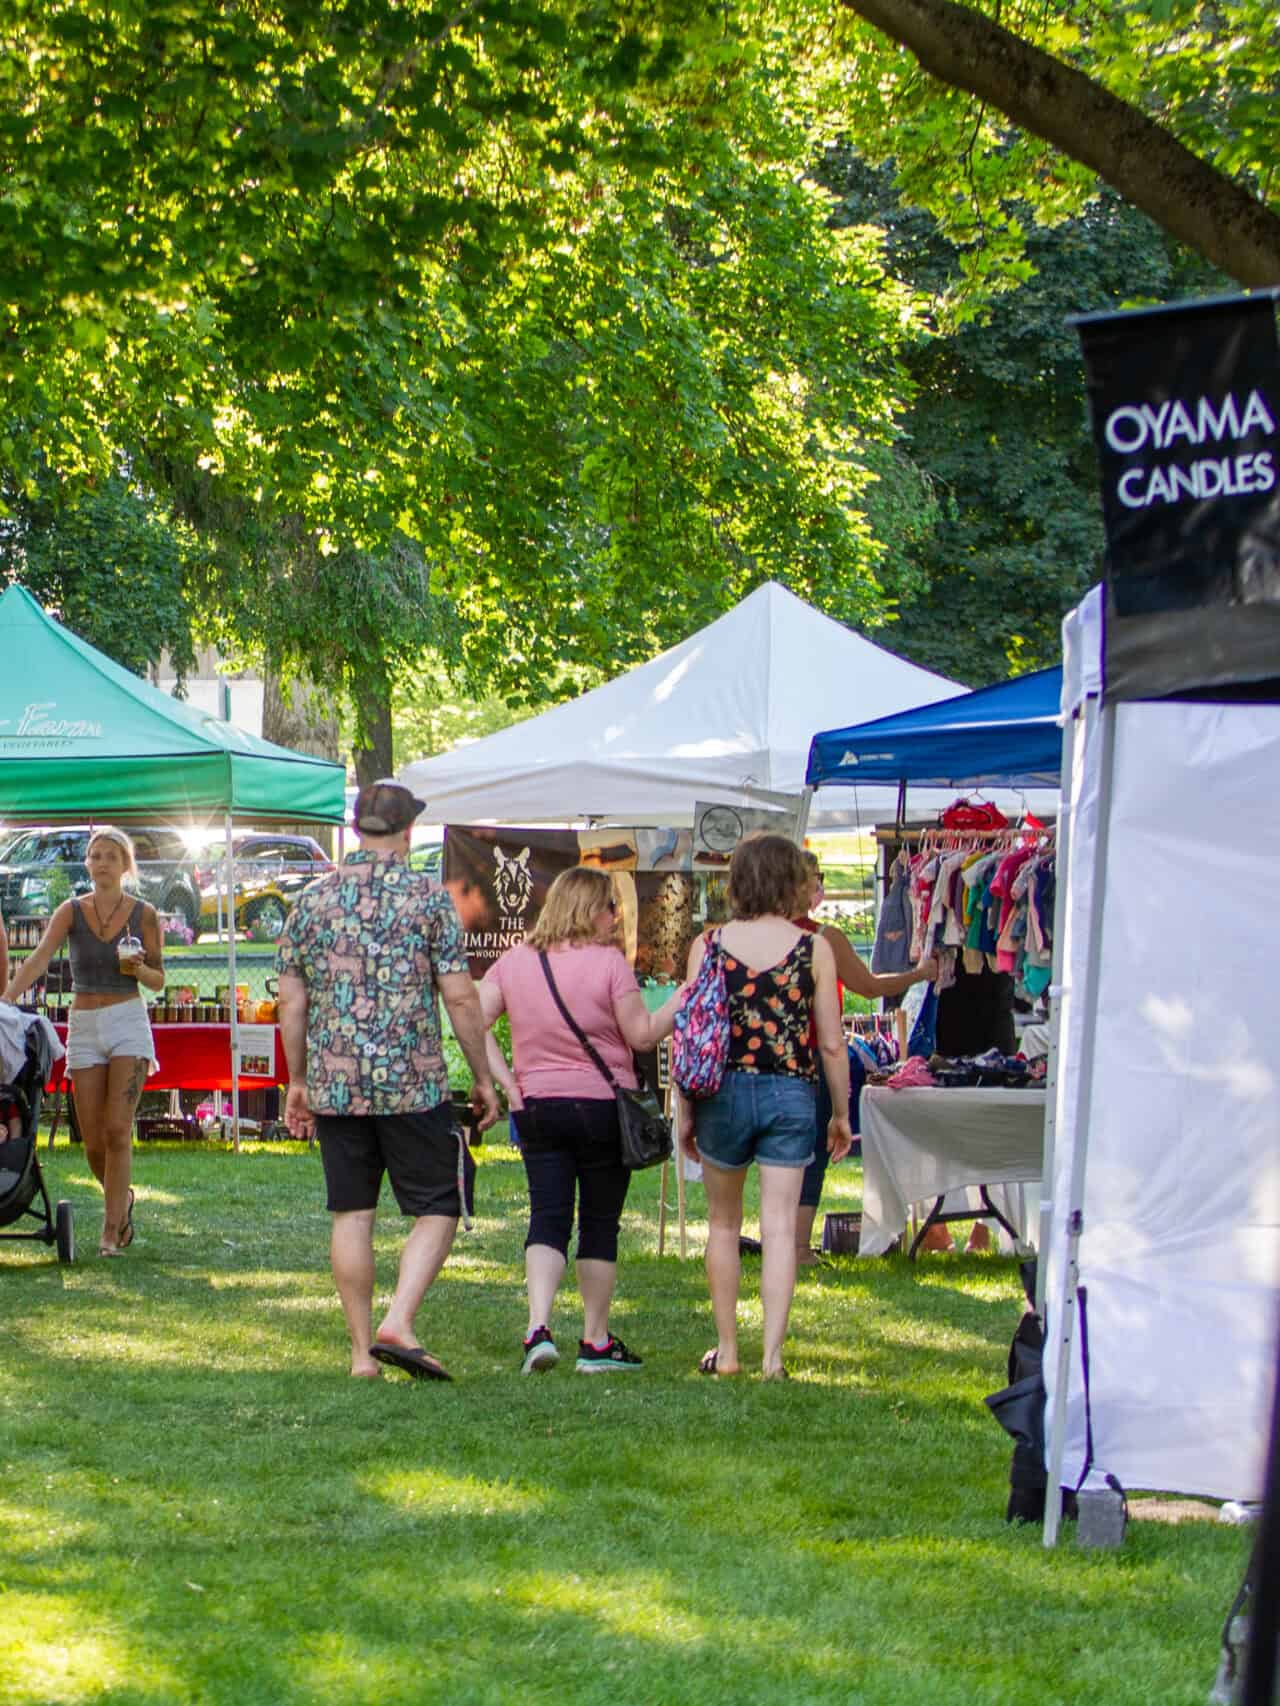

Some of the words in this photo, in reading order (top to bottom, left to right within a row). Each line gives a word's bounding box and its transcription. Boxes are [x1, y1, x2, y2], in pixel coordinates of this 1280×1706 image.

[1104, 389, 1276, 453] OYAMA
[1117, 451, 1276, 509] CANDLES
[463, 931, 522, 948] IMPING
[499, 916, 525, 931] THE
